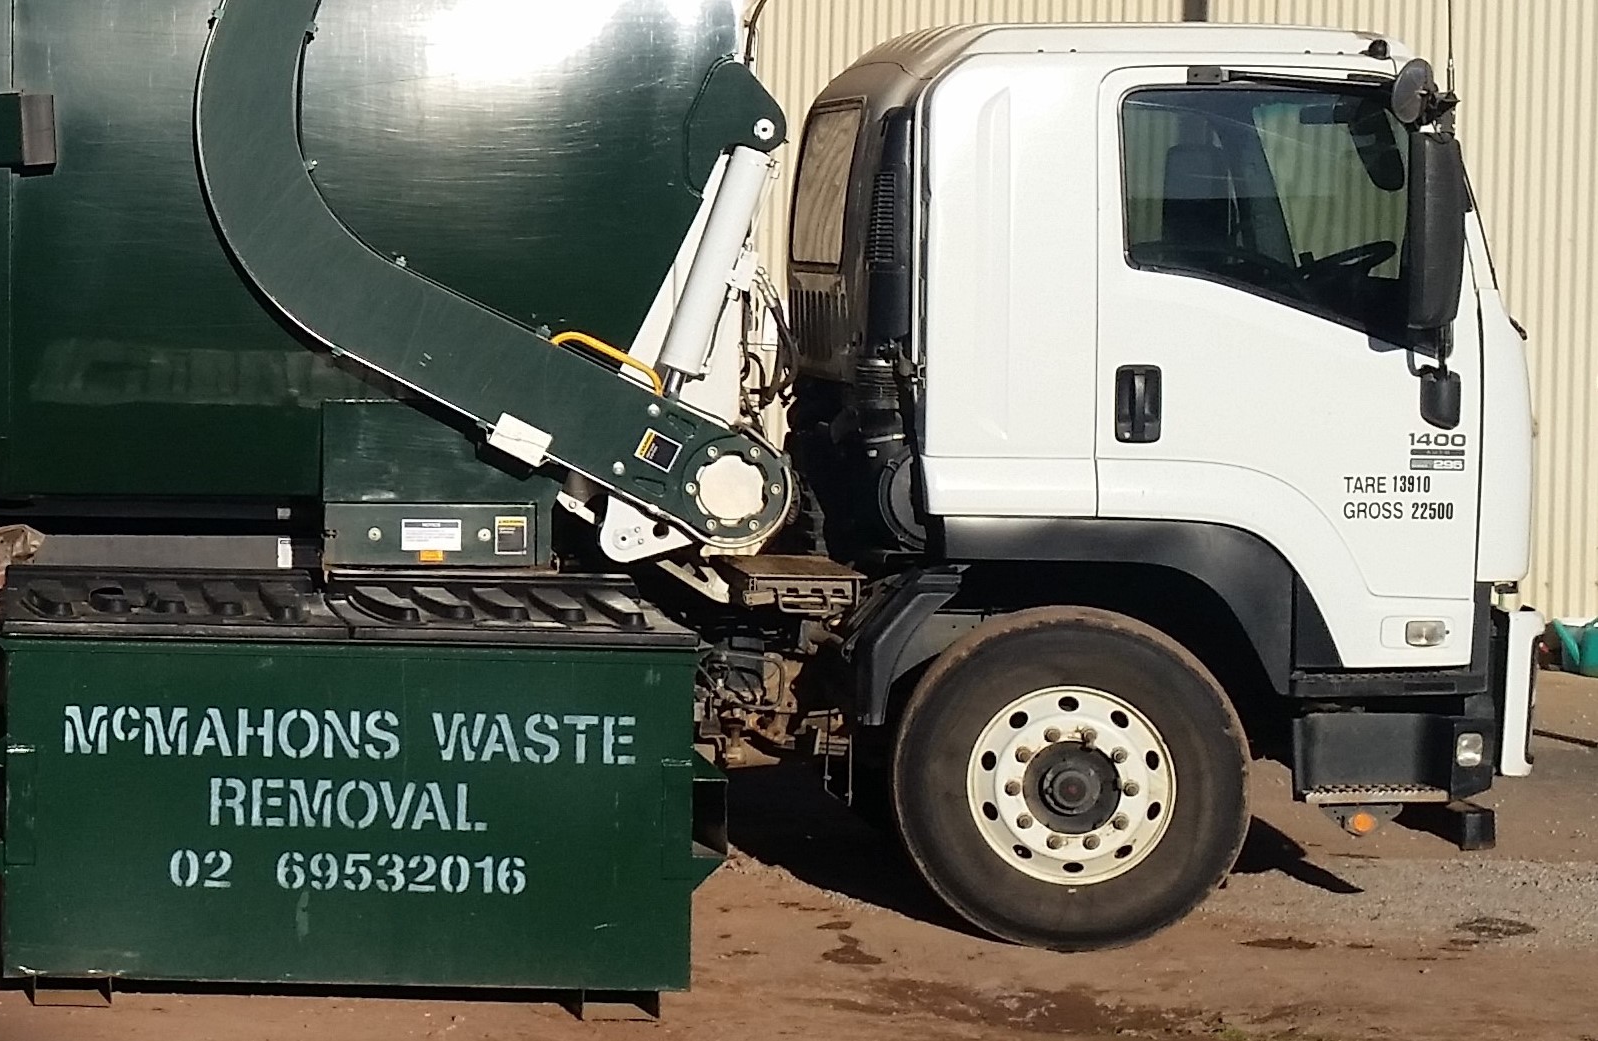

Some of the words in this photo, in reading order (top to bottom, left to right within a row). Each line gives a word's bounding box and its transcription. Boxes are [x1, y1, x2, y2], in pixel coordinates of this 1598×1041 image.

[1408, 432, 1467, 447] 1400
[1343, 476, 1387, 494] TARE
[1392, 475, 1431, 493] 13910
[1343, 501, 1404, 520] GROSS
[1411, 502, 1454, 520] 22500
[432, 712, 636, 765] WASTE
[209, 777, 487, 832] REMOVAL
[169, 849, 232, 888] 02
[276, 852, 526, 895] 69532016
